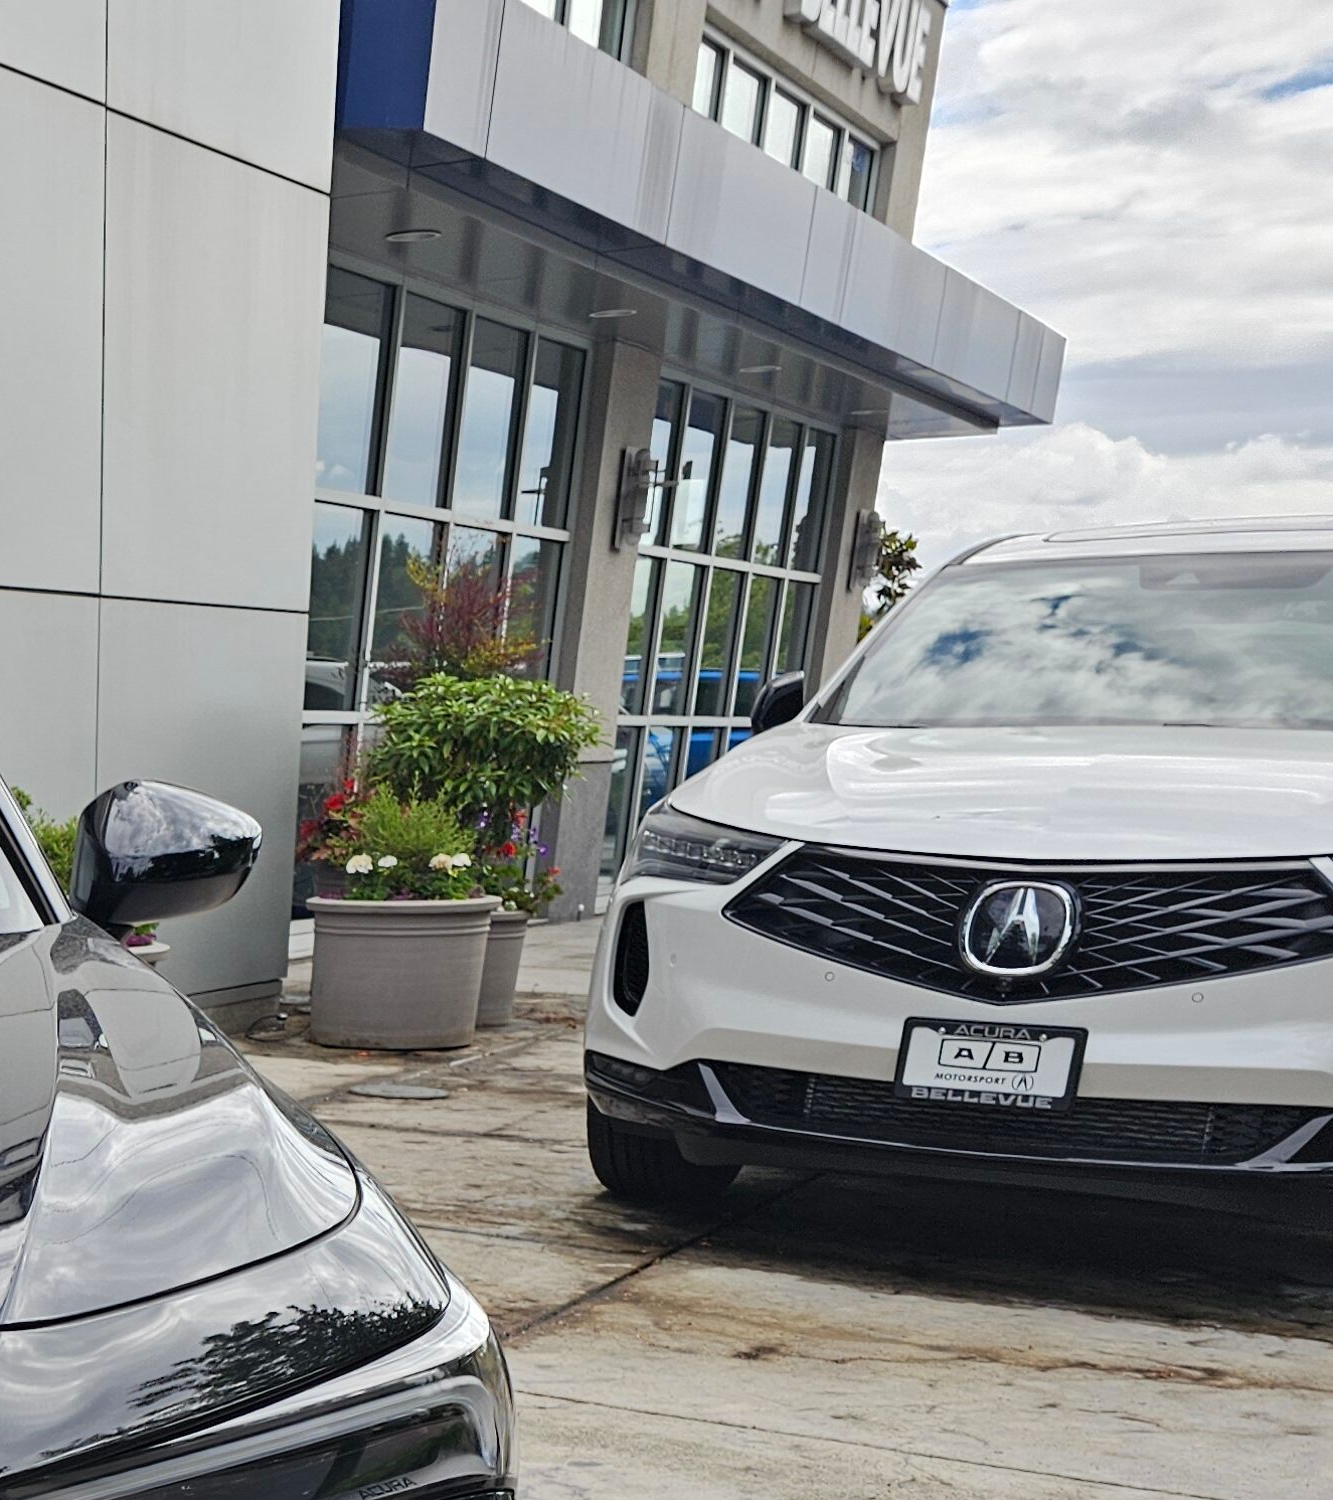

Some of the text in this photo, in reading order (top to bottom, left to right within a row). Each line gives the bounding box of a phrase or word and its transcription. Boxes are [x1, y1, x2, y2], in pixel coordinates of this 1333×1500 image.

[801, 0, 931, 104] LLEVUE
[954, 1024, 1031, 1040] ACURA
[934, 1072, 1006, 1085] MOTORSPORT
[911, 1086, 1052, 1109] BELLEVUE
[358, 1476, 417, 1500] ACURA
